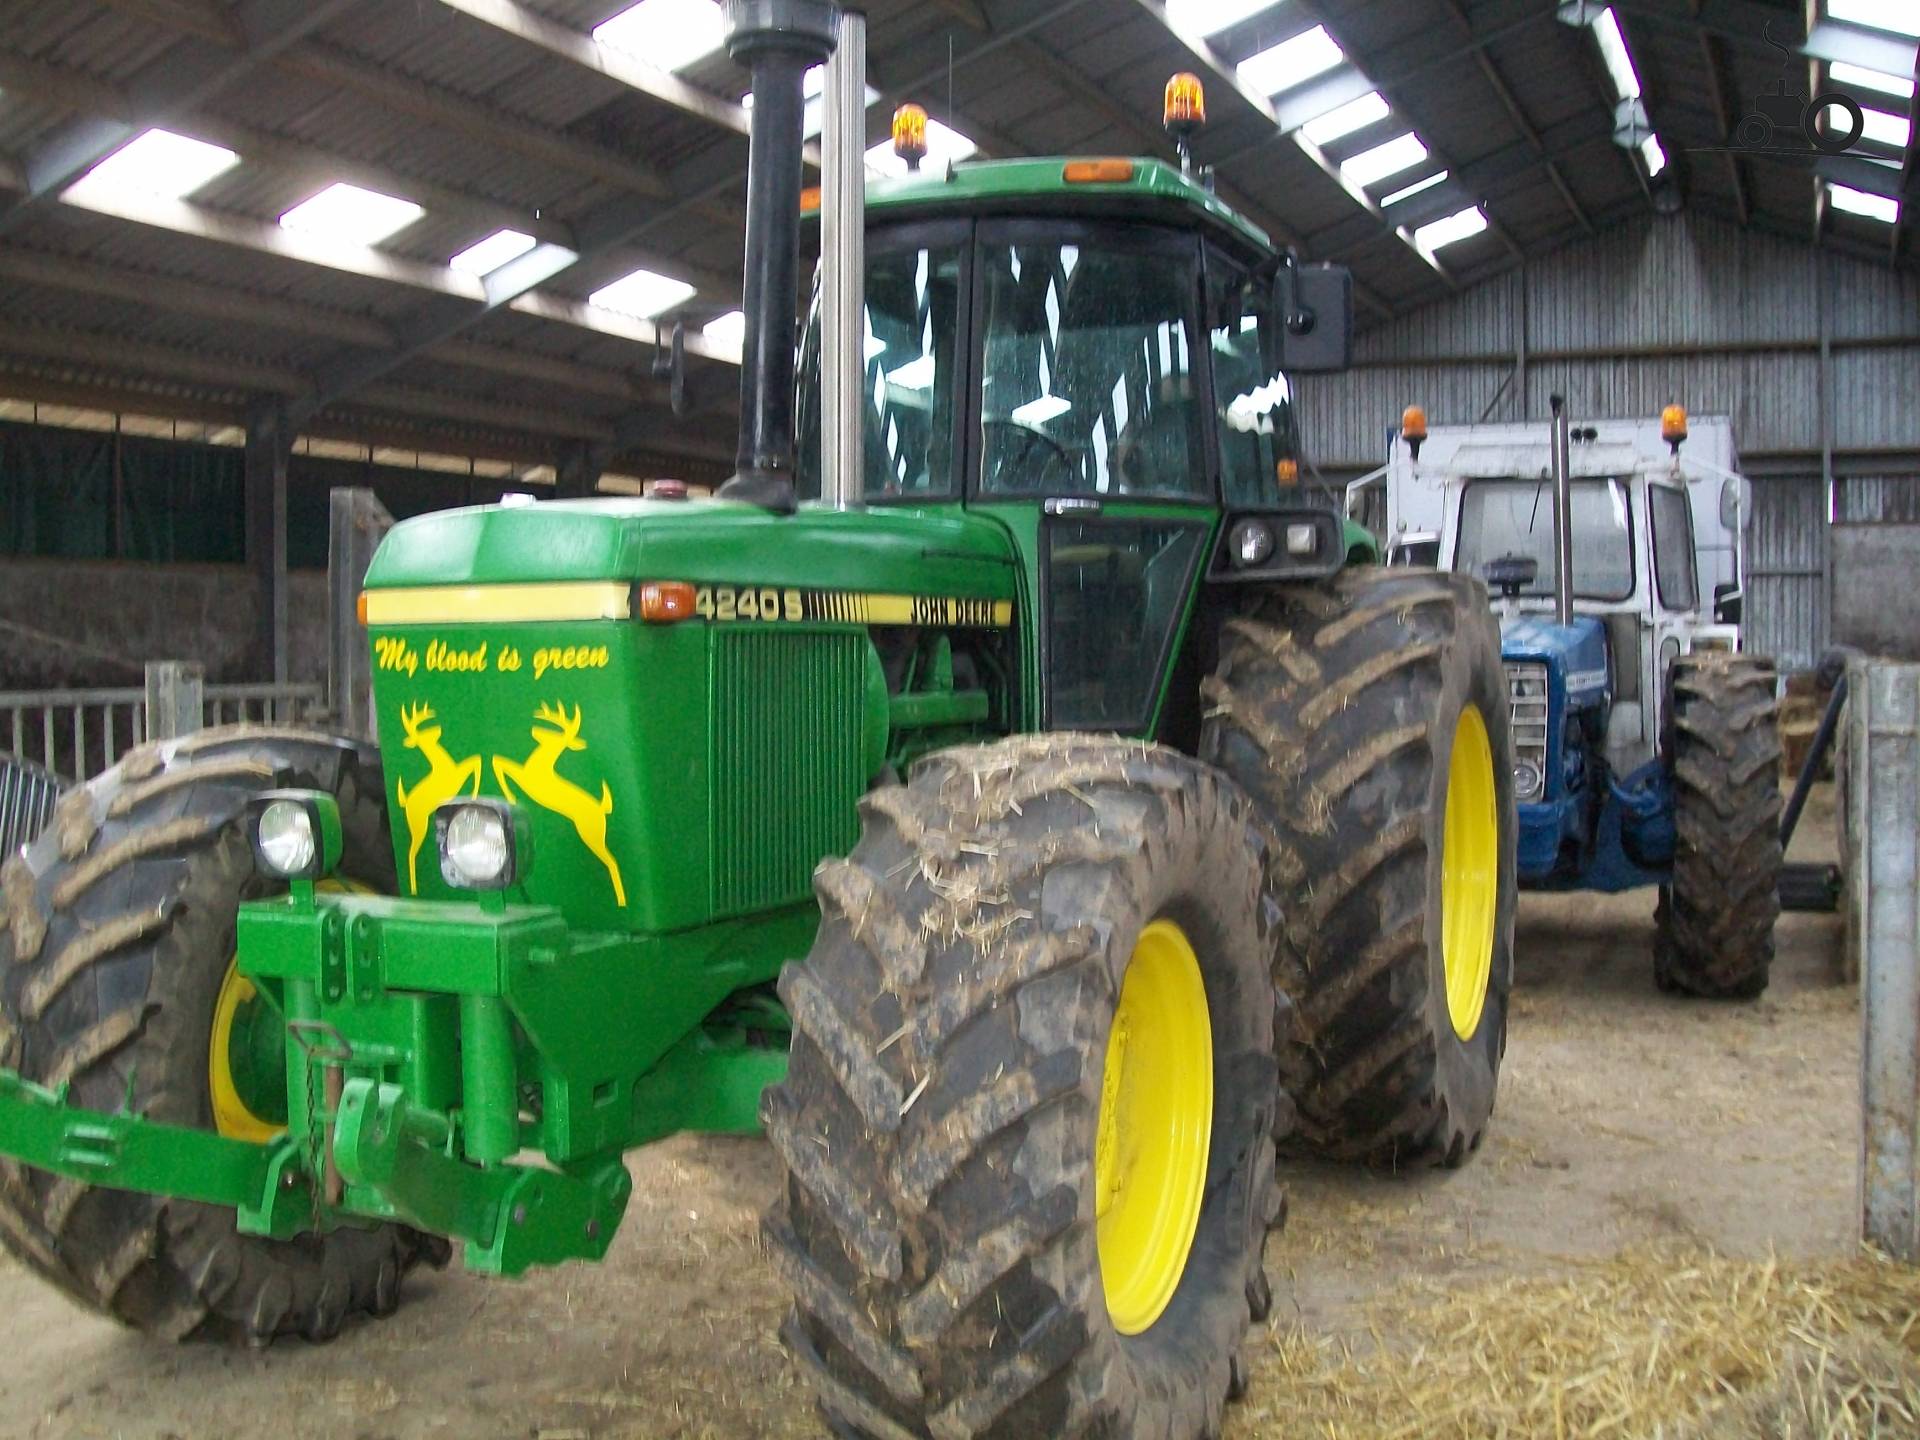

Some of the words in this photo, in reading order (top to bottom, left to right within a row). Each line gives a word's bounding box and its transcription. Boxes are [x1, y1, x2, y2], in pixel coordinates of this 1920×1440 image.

[911, 597, 948, 624] JOHN
[956, 598, 996, 626] DEERE
[375, 636, 418, 679] My
[426, 639, 487, 672] blood
[497, 645, 522, 672] is
[533, 645, 609, 680] green
